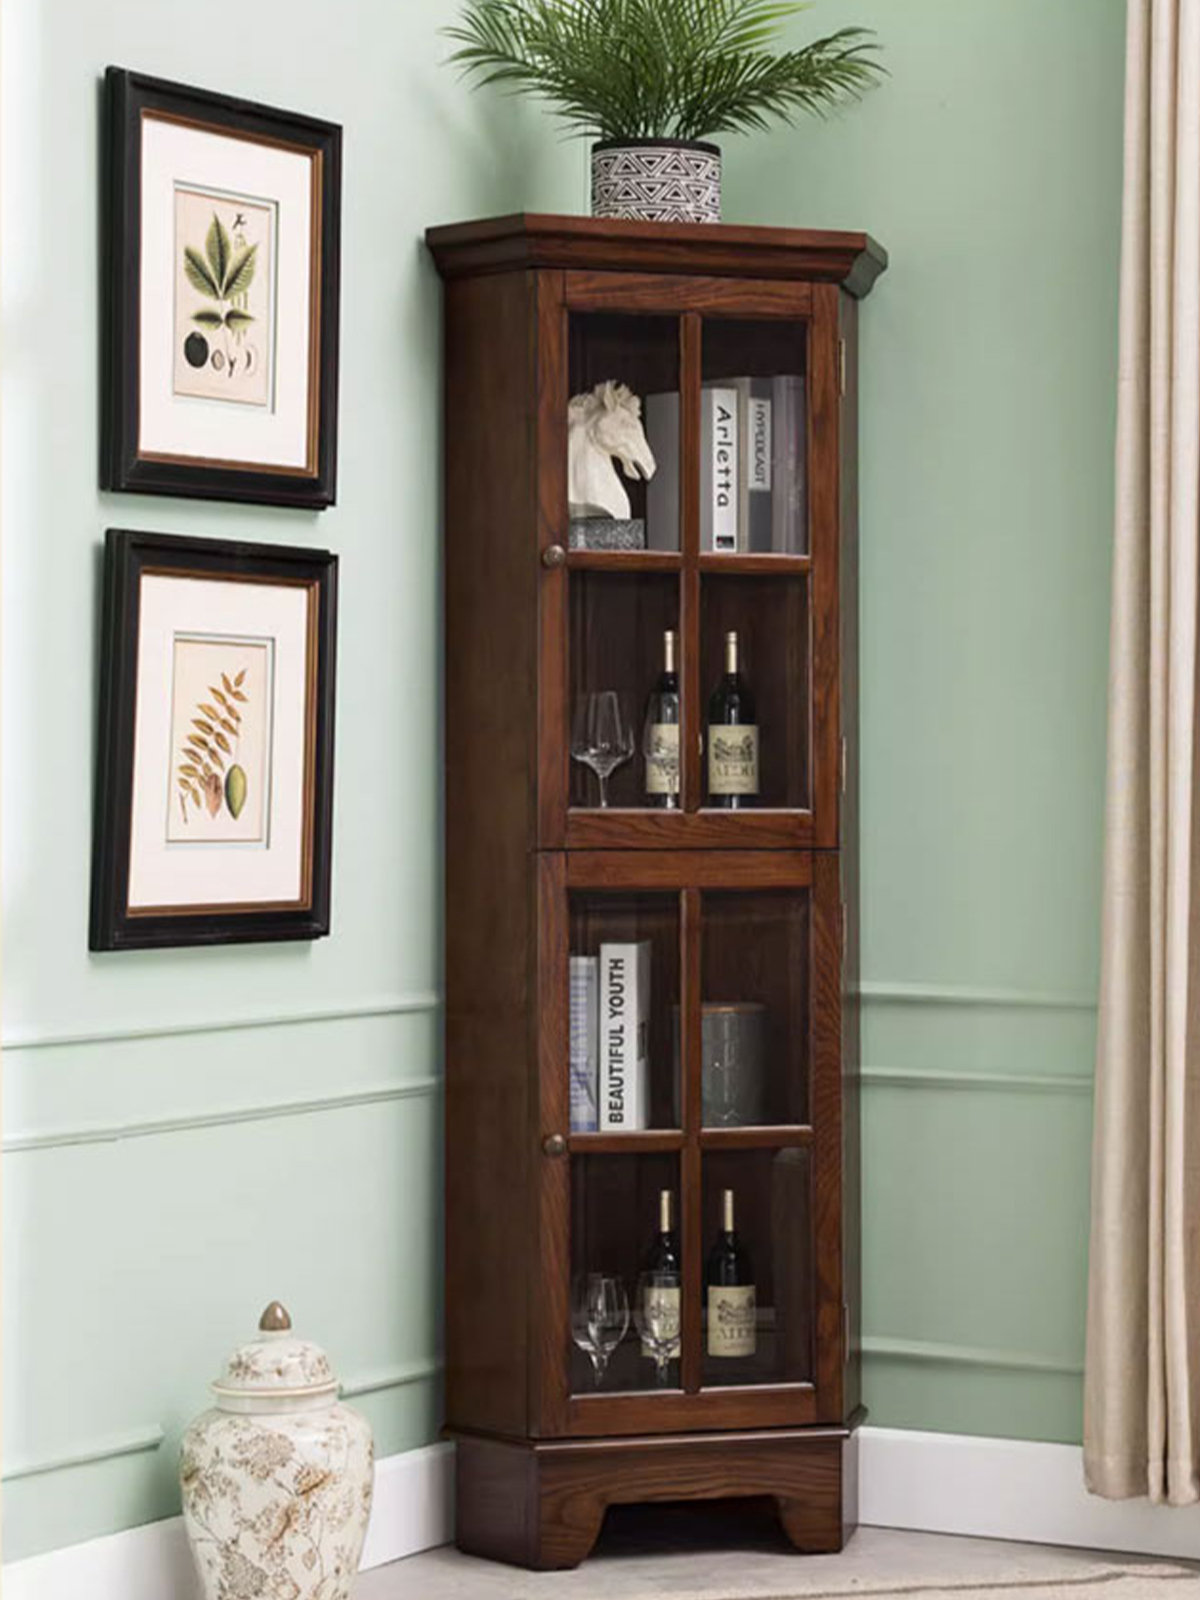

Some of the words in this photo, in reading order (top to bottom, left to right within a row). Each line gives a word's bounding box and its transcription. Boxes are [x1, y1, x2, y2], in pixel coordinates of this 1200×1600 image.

[716, 405, 733, 507] Arletta
[609, 958, 625, 1019] YOUTH
[609, 1024, 625, 1123] BEAUTIFUL
